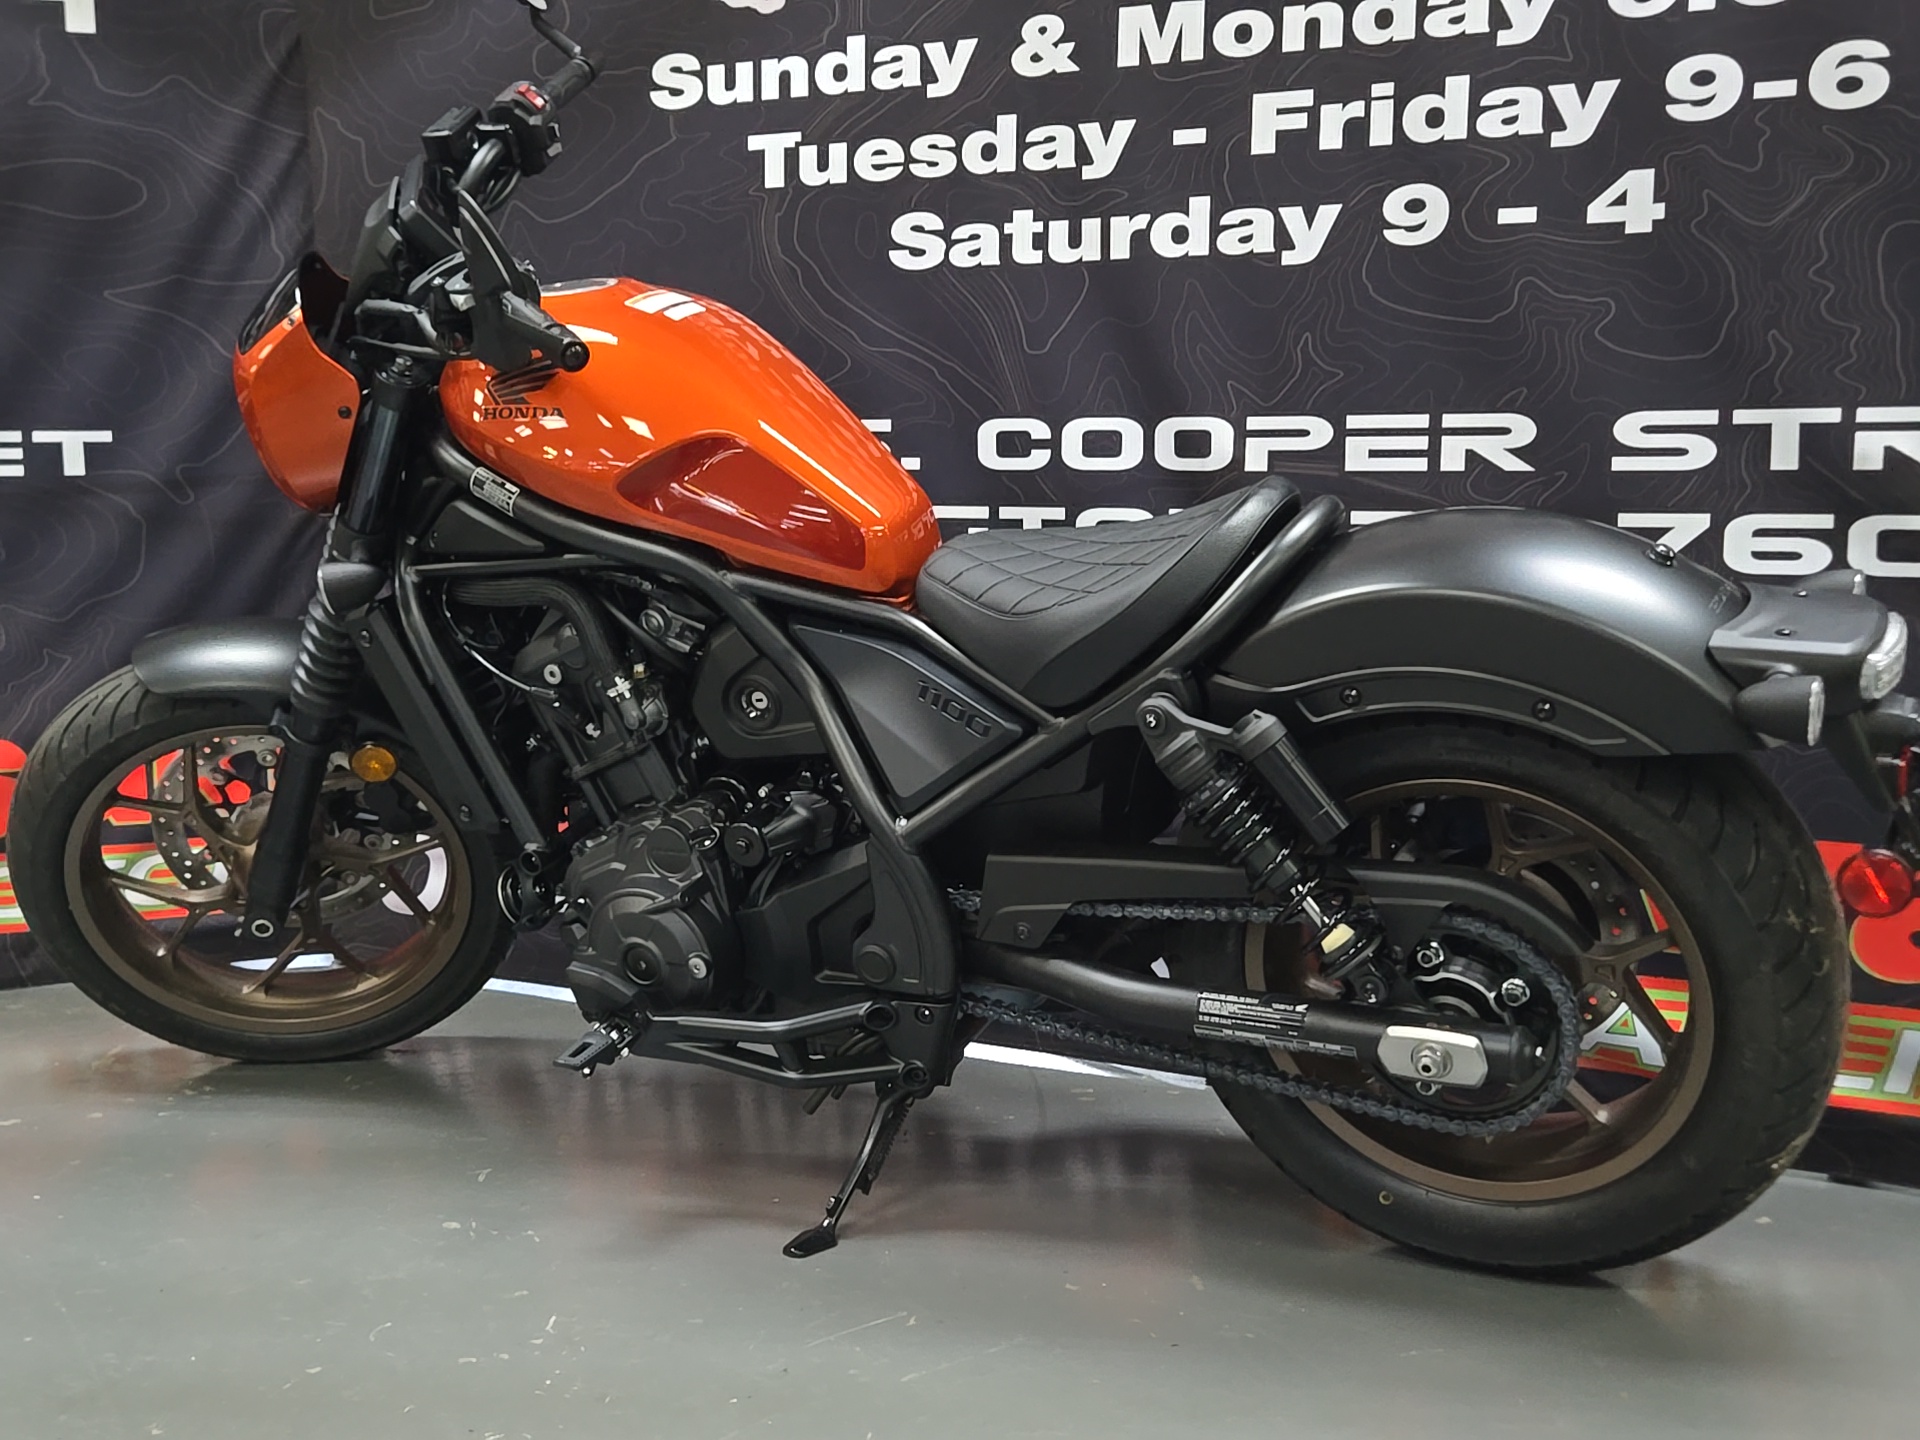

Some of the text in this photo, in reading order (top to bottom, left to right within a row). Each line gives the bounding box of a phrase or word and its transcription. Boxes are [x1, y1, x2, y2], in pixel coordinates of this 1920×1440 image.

[650, 0, 1556, 111] Sunday & Monday
[747, 39, 1891, 189] Tuesday - Friday 9-6
[888, 168, 1666, 271] Saturday 9 - 4
[482, 405, 566, 421] HONDA
[977, 413, 1538, 472] COOPER
[917, 680, 992, 739] 1100
